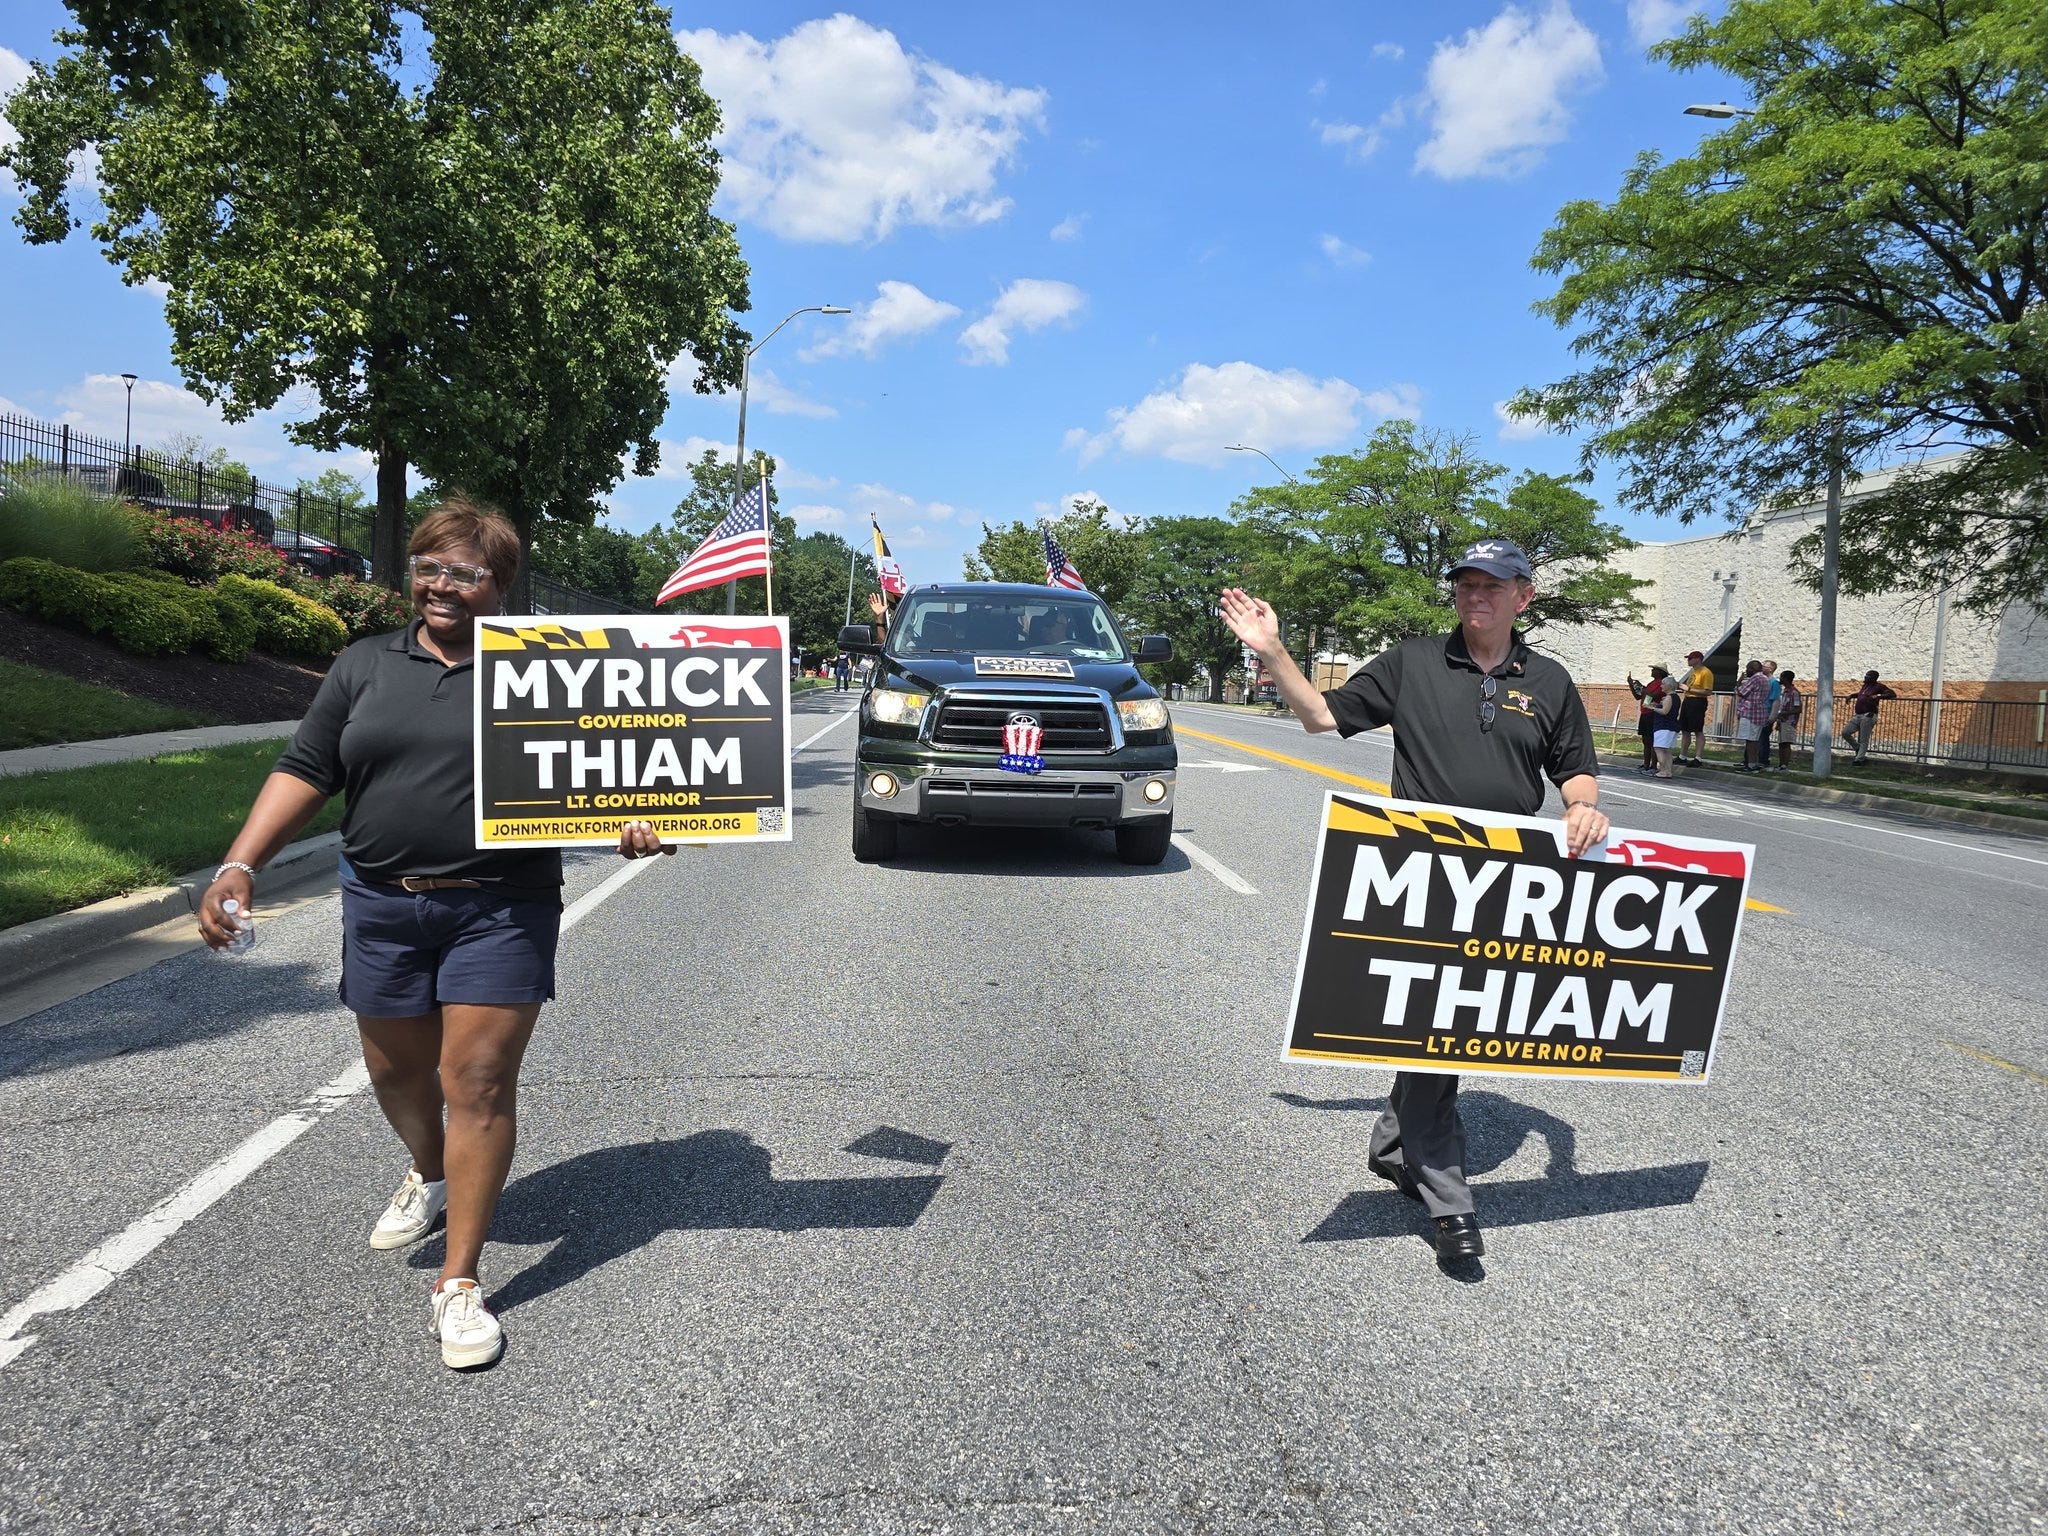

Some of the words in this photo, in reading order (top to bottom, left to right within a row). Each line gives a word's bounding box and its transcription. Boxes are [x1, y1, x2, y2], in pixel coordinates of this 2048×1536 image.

[981, 659, 1064, 667] MYRICK
[991, 664, 1058, 672] THIAM
[493, 657, 771, 709] MYRICK
[578, 714, 687, 729] GOVERNOR
[524, 737, 742, 789] THIAM
[566, 795, 590, 809] LT.
[594, 792, 701, 808] GOVERNOR
[493, 819, 741, 836] JOHNMYRICKFORMVERNOR.ORG
[1343, 844, 1718, 954] MYRICK
[1463, 938, 1606, 969] GOVERNOR
[1369, 958, 1673, 1042] THIAM
